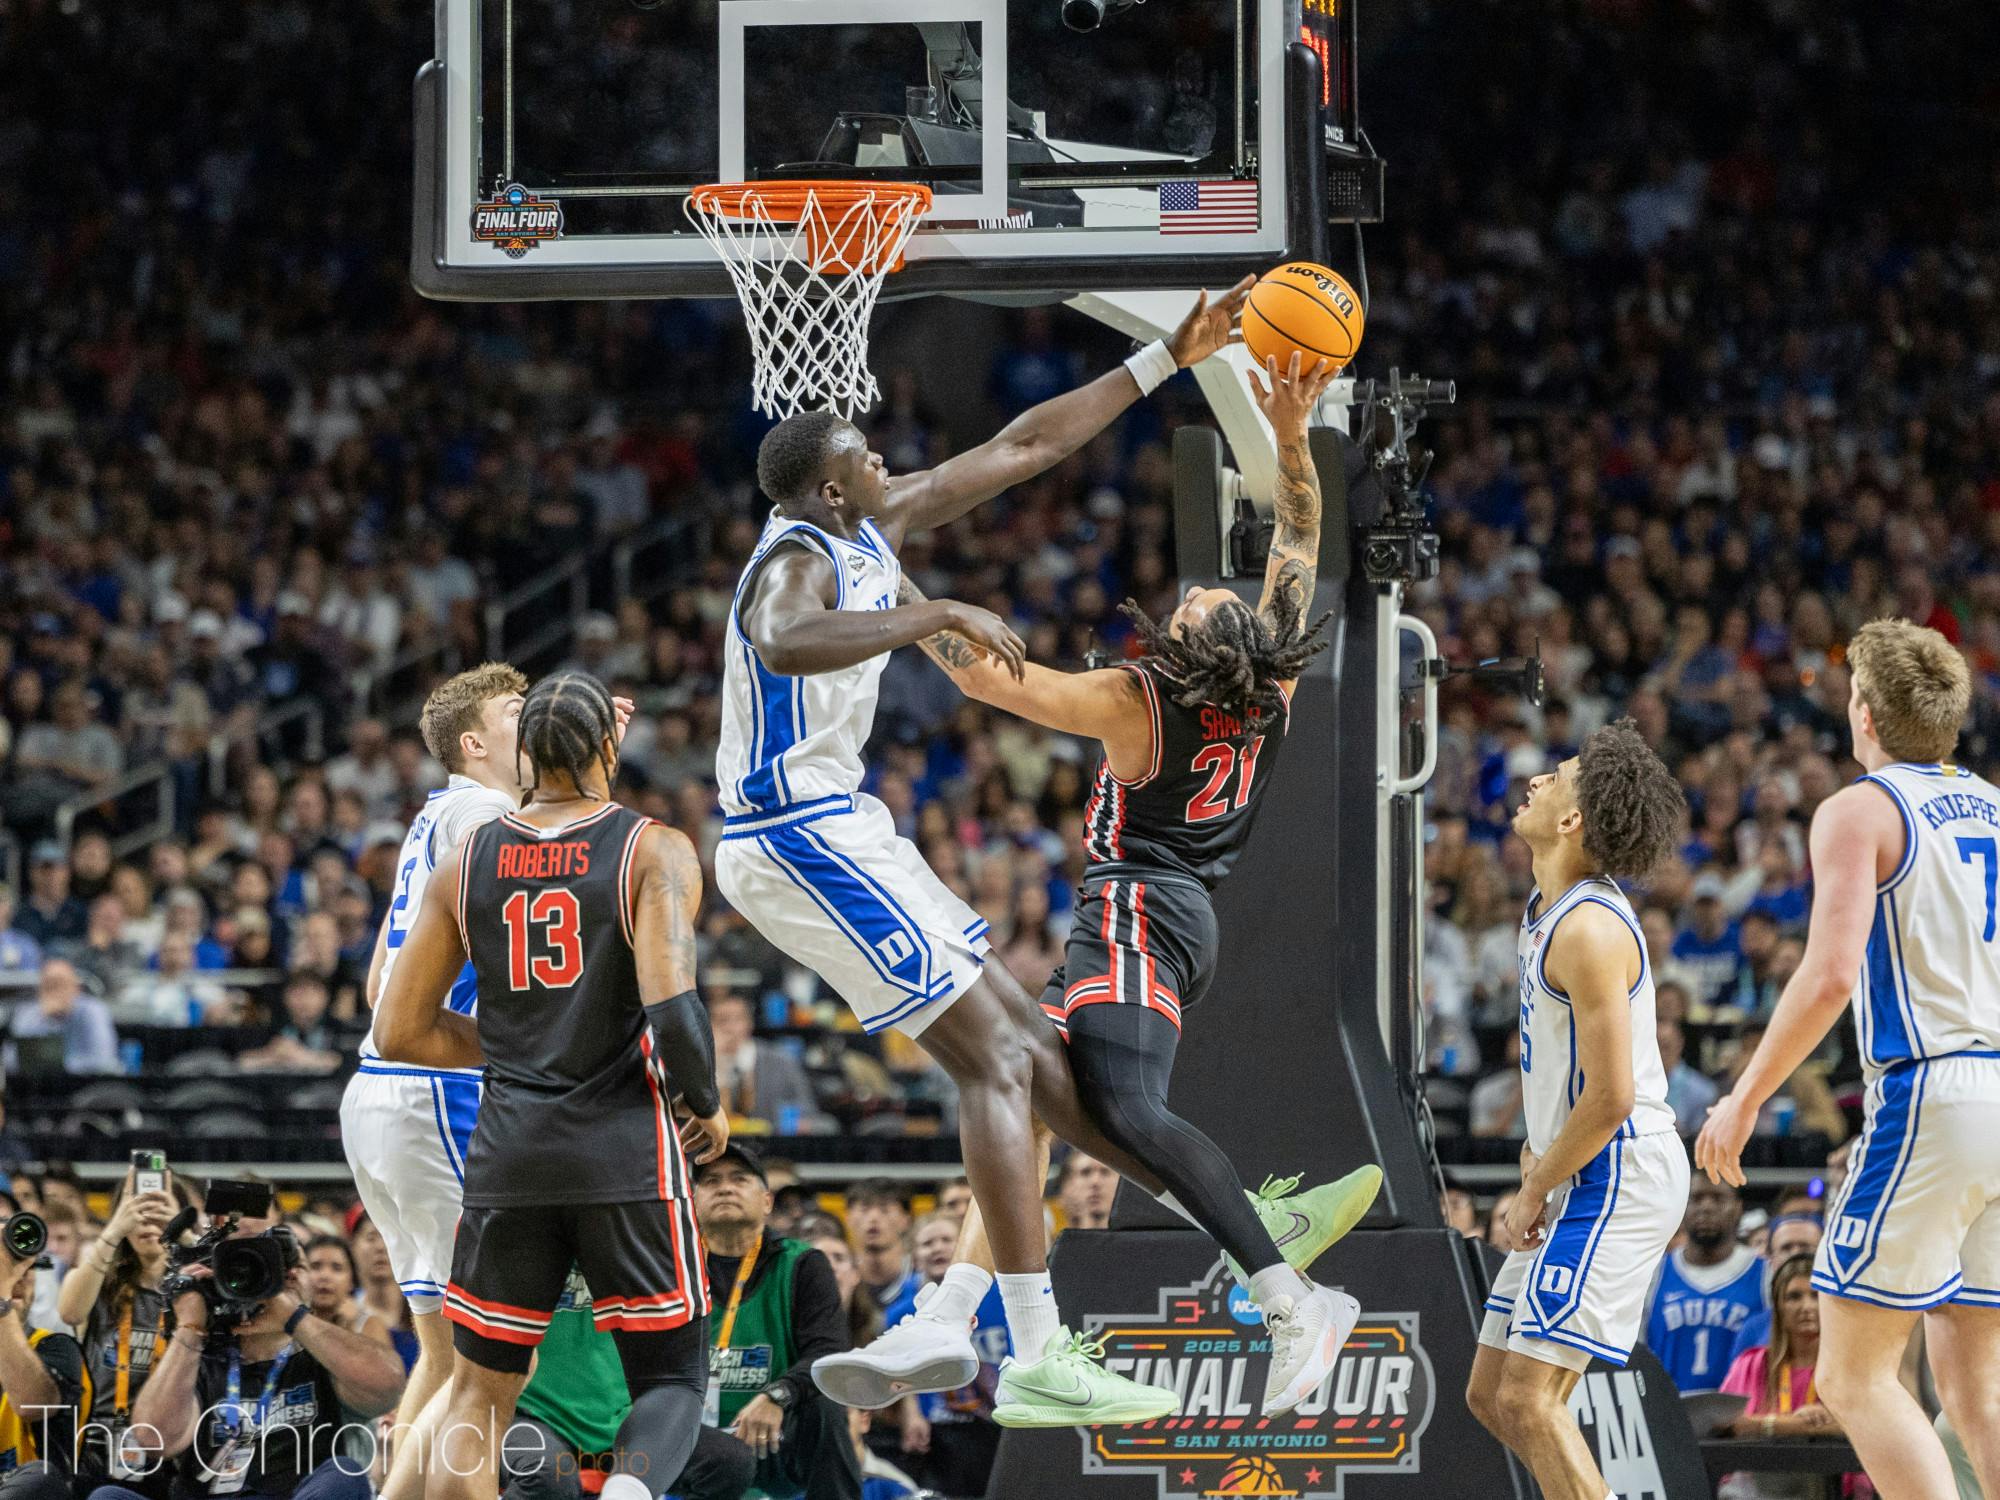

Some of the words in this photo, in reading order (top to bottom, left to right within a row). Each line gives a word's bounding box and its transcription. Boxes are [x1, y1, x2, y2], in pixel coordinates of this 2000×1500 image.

[475, 211, 518, 229] FINAL
[518, 210, 559, 228] FOUR
[1200, 706, 1262, 740] SHA
[1185, 735, 1266, 823] 21
[1919, 793, 2000, 831] KNUEPPE
[497, 841, 592, 879] ROBERTS
[387, 856, 418, 949] 2
[1954, 836, 1999, 943] 7
[502, 887, 584, 991] 13
[1231, 1300, 1262, 1313] NCA
[1662, 1298, 1750, 1333] DUKE
[1184, 1340, 1242, 1353] 2025
[1691, 1328, 1710, 1377] 1
[1174, 1435, 1220, 1448] SAN
[1226, 1434, 1328, 1448] ANTONIO
